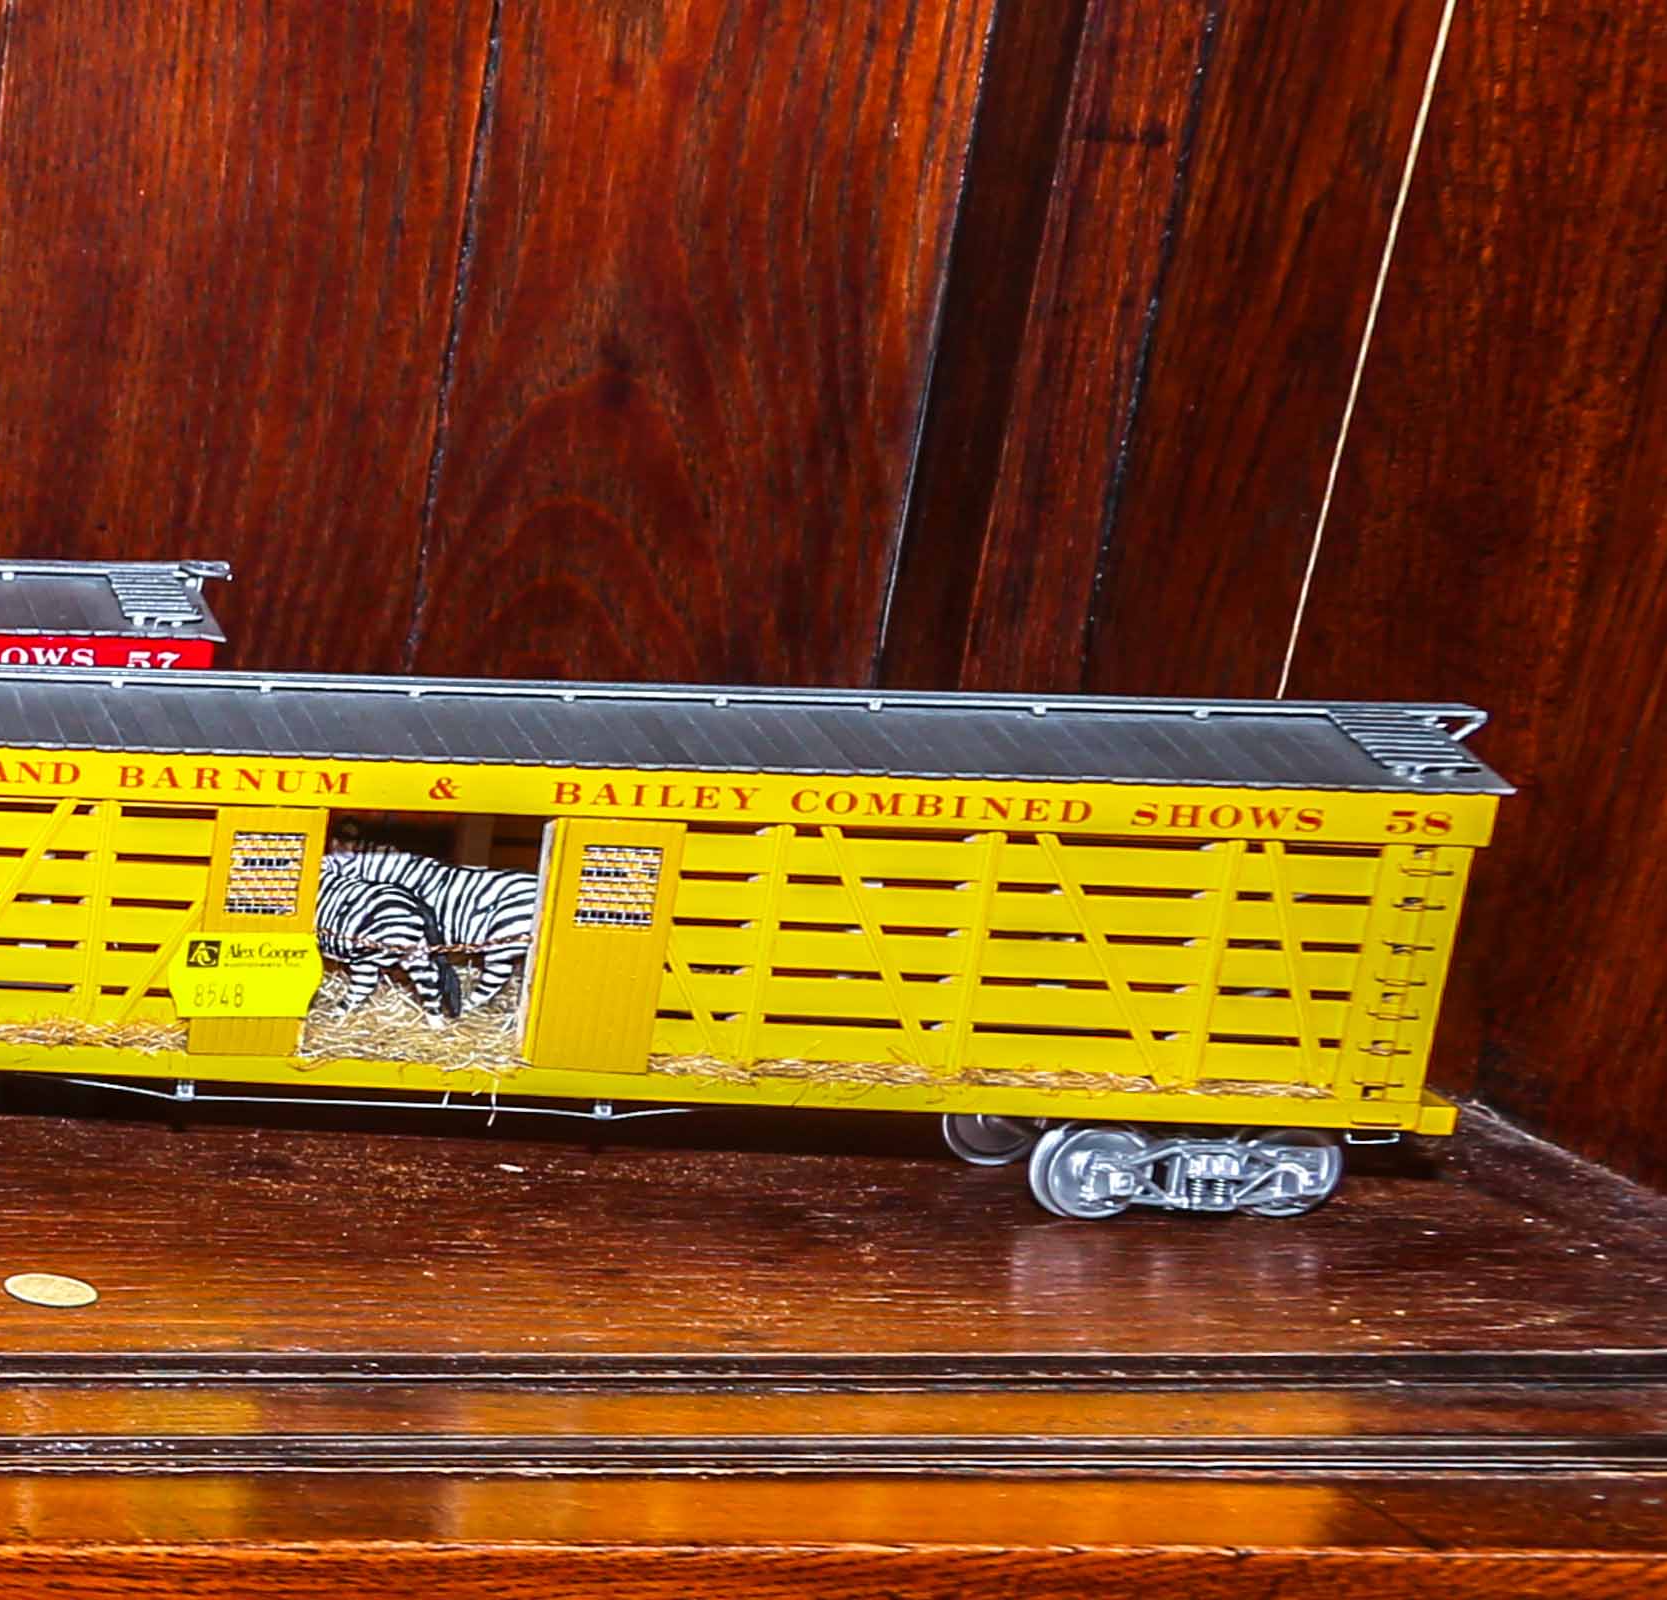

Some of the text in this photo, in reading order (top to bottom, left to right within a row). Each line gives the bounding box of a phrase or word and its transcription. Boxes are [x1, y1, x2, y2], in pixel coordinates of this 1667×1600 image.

[119, 764, 351, 795] BARNUM
[428, 776, 462, 800] &
[553, 782, 761, 812] BAILEY
[791, 788, 1093, 825] COMBINED
[1130, 802, 1325, 833] SHOWS
[1385, 809, 1454, 836] 58
[225, 944, 256, 959] Alex
[259, 943, 308, 962] Cooper
[193, 983, 244, 1008] 8548
